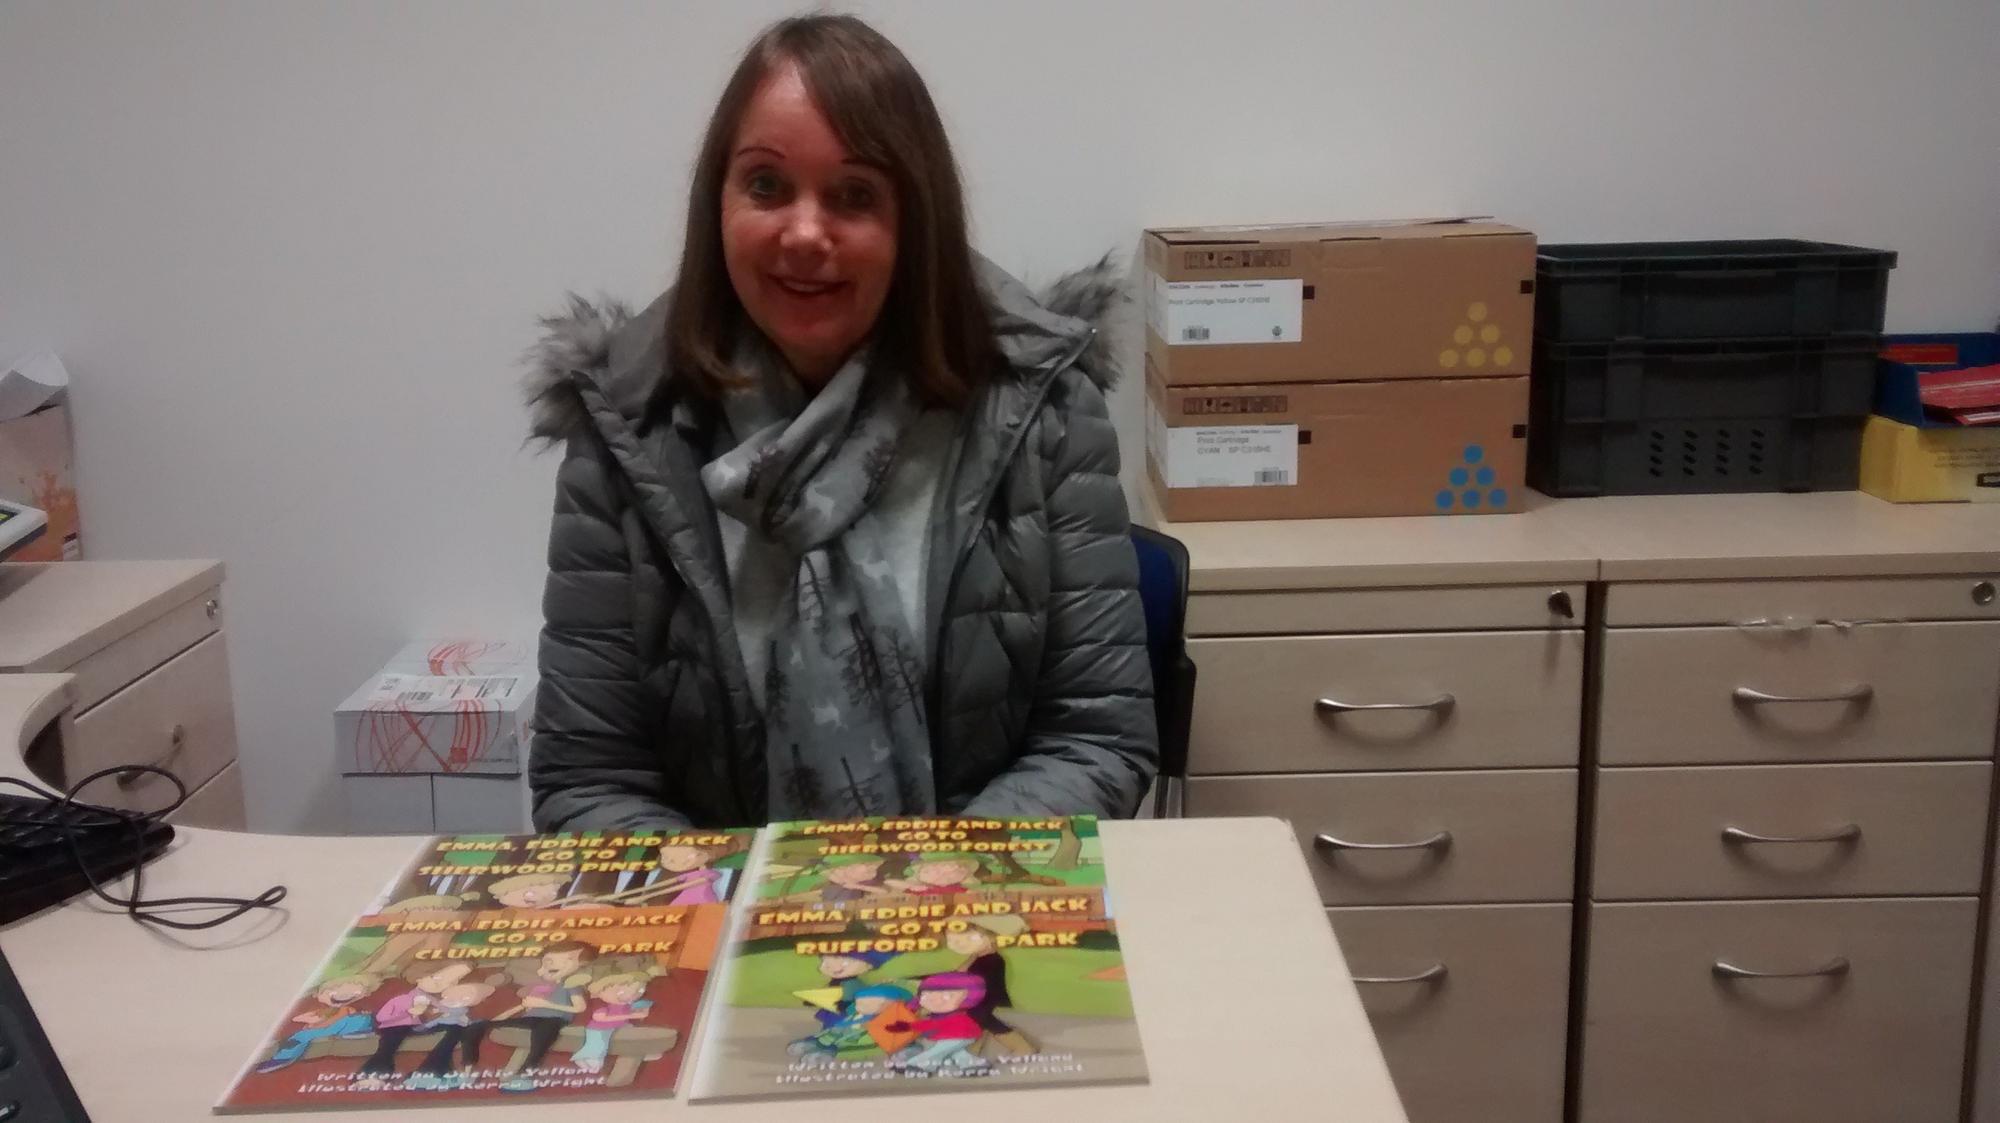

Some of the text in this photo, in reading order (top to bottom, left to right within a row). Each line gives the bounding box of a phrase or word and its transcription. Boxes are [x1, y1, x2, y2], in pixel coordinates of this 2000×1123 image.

[1197, 447, 1220, 455] CYAN
[803, 820, 1065, 836] EMMA, EDDIE AND JACK
[897, 831, 967, 841] GO TO
[436, 835, 731, 852] EMMA, EDDIE AND JACK
[817, 841, 1050, 855] SHERWOOD FOREST
[537, 850, 618, 862] GO TO
[418, 860, 659, 876] SHERWOOD PINES
[759, 899, 1089, 925] EMMA, EDDIE AND JACK
[386, 913, 685, 933] EMMA, EDDIE AND JACK
[879, 920, 969, 936] GO TO
[488, 931, 569, 944] GO TO
[795, 932, 1081, 955] RUFFORD PARK
[415, 941, 676, 960] CLUMBER PARK
[316, 1071, 403, 1082] Written
